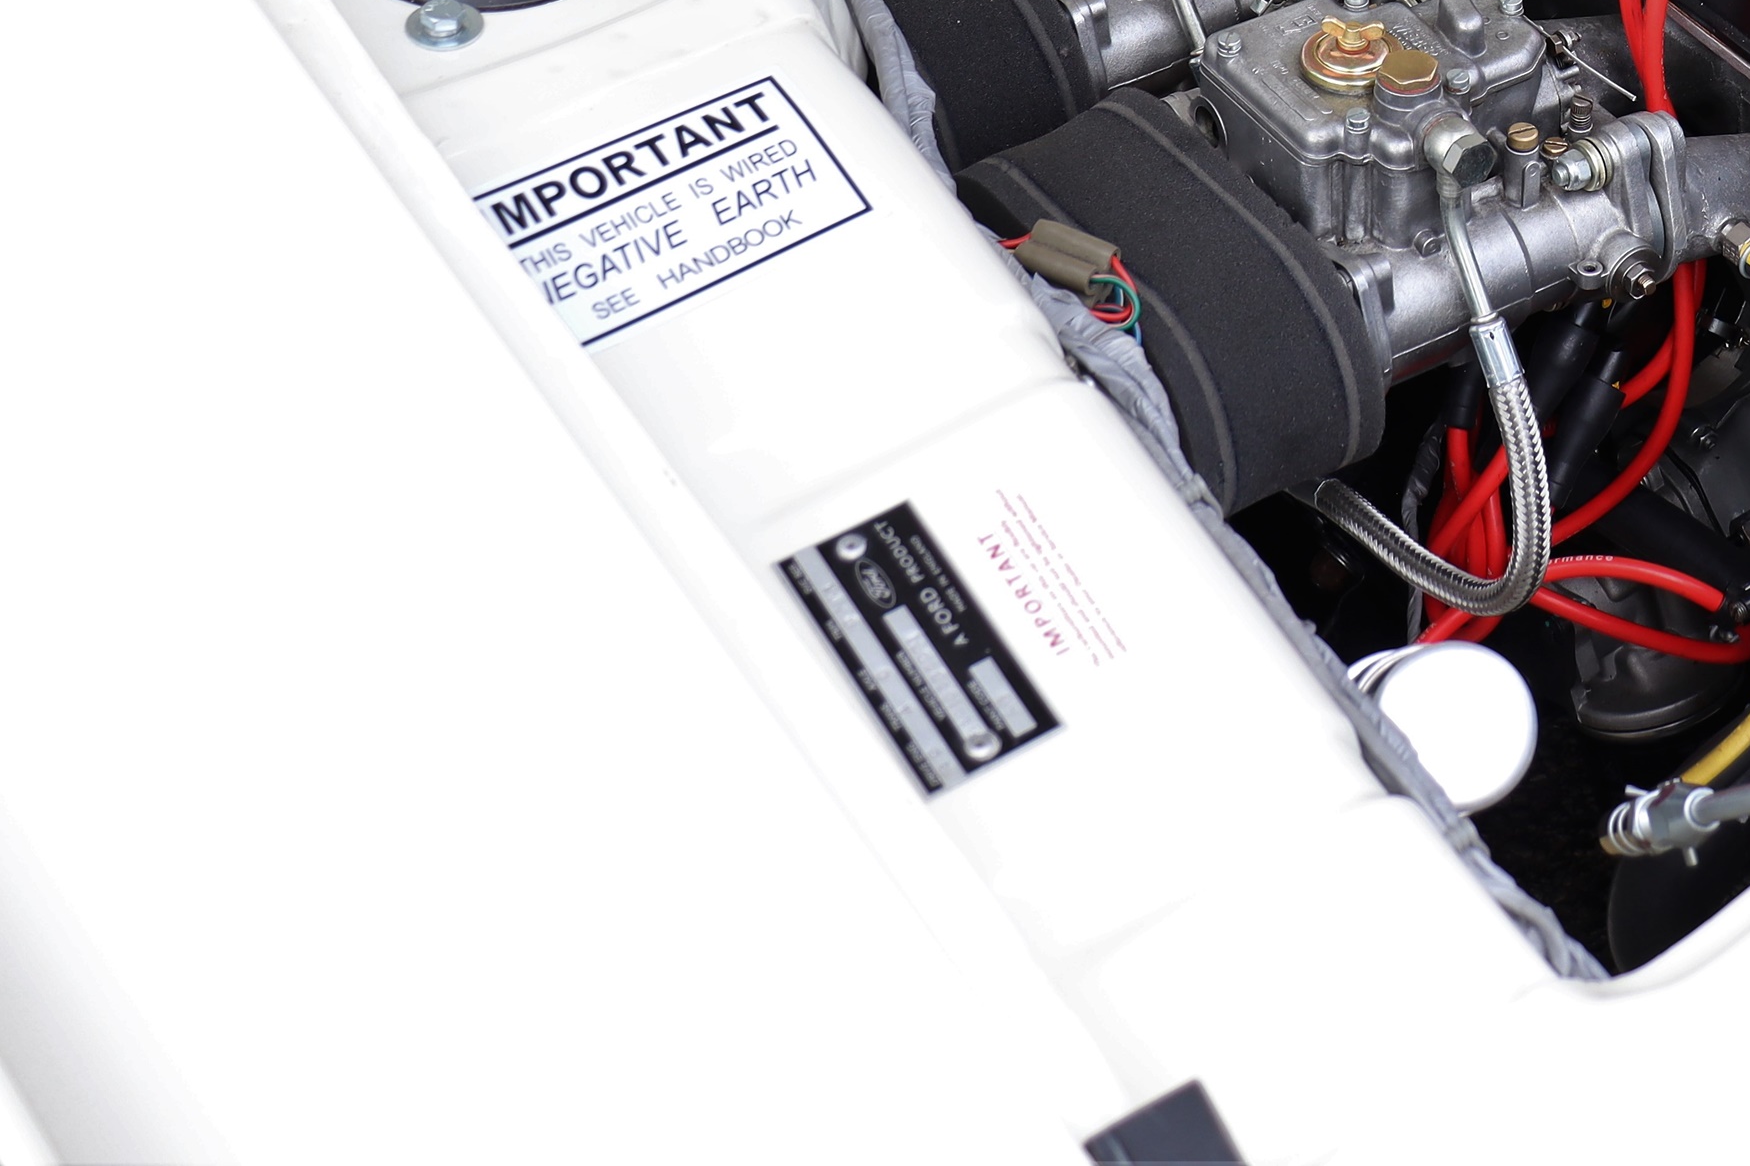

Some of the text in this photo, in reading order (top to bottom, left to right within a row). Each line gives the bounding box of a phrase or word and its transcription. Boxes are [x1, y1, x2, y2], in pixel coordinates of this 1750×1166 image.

[490, 92, 772, 235] MPORTANT
[579, 191, 682, 249] VEHICLE
[688, 177, 715, 200] IS
[720, 139, 799, 184] WIRED
[711, 159, 817, 226] EARTH
[591, 209, 803, 321] SEE HANDBOOK
[857, 562, 893, 604] Ford
[873, 516, 925, 585] PRODUCT
[917, 583, 960, 636] FORD
[976, 529, 1070, 657] IMPORTANT
[951, 631, 969, 649] A
